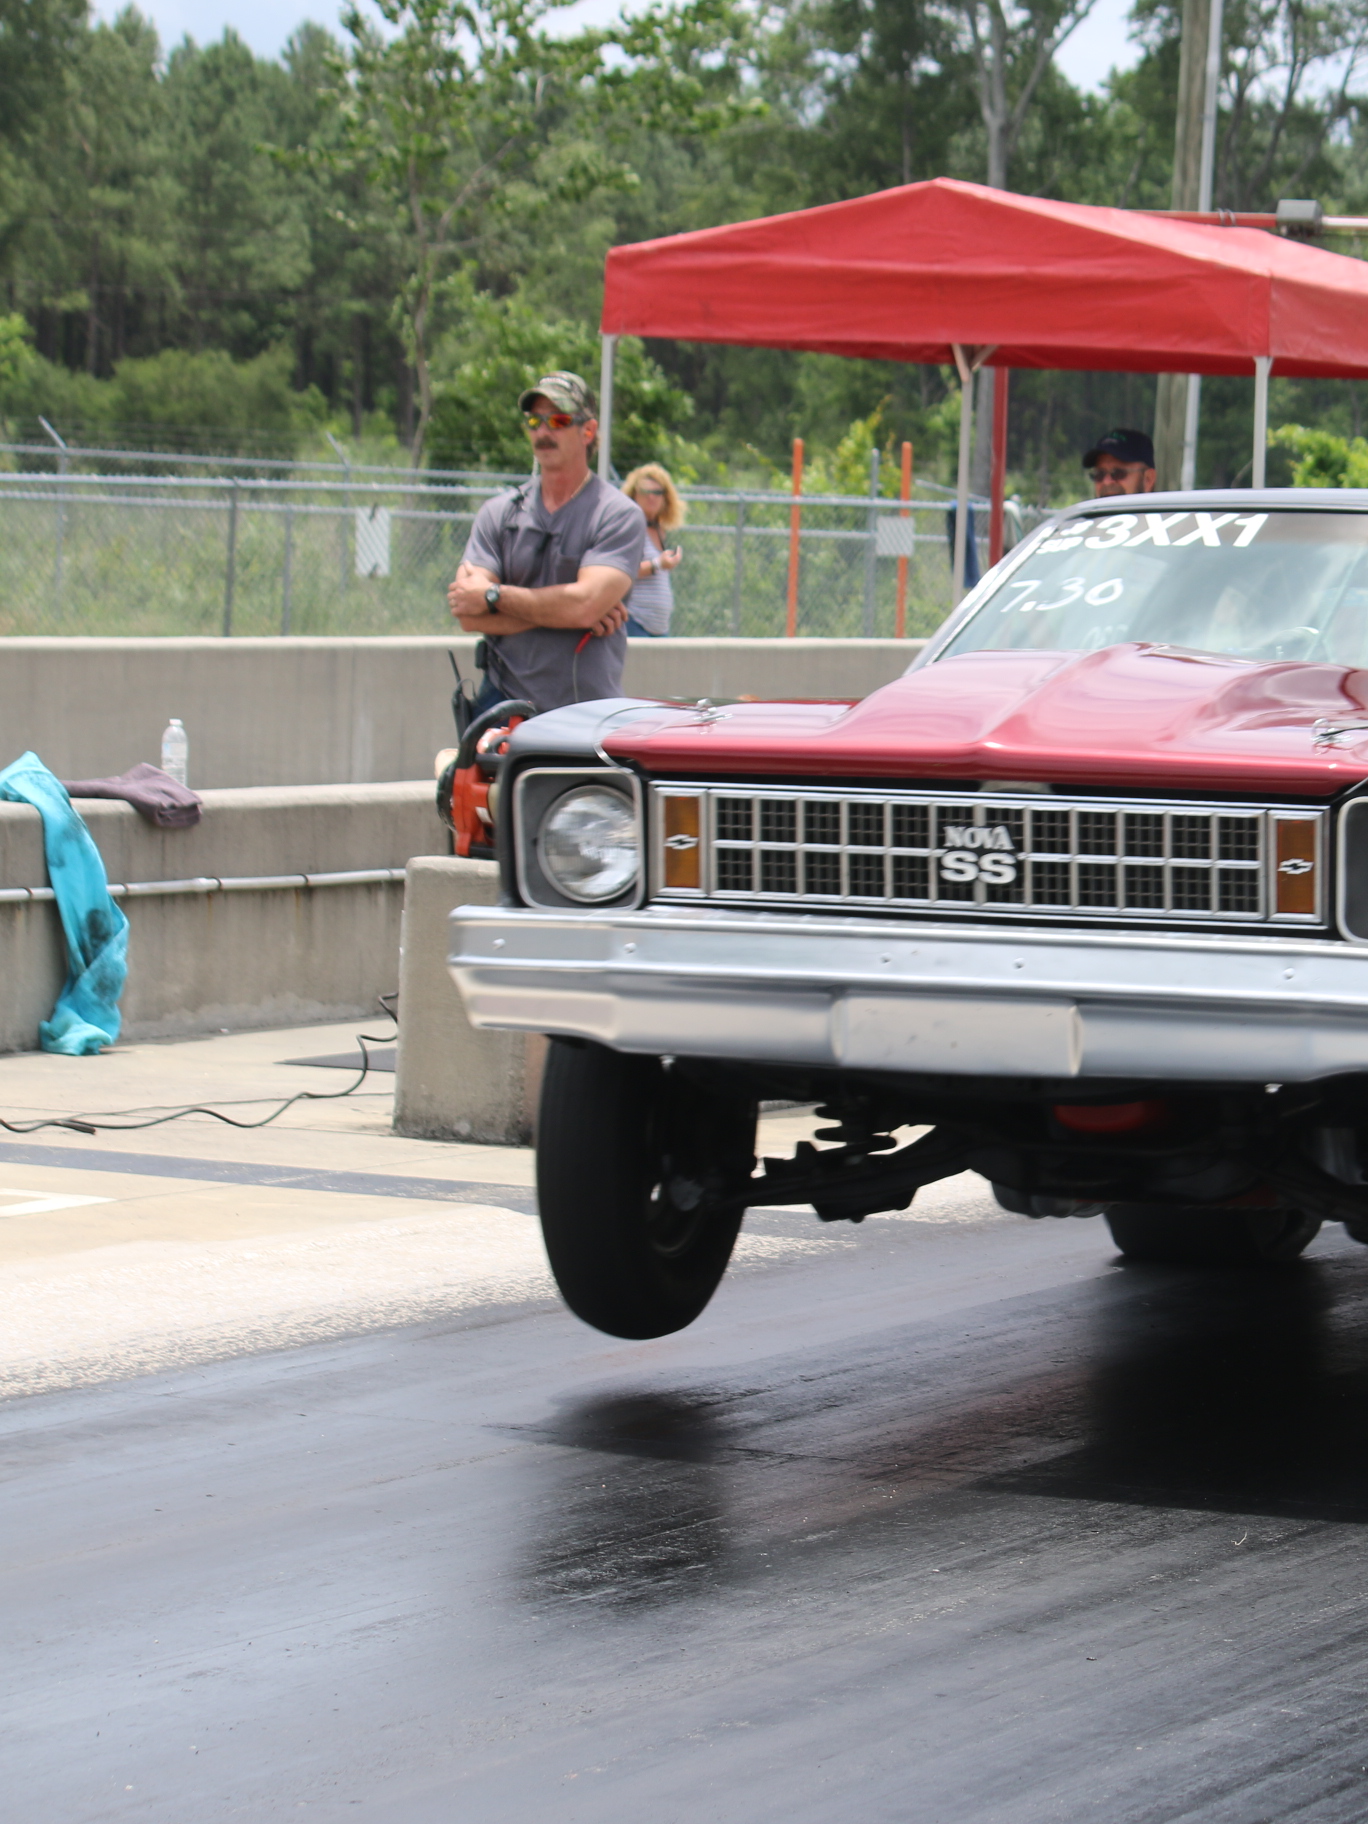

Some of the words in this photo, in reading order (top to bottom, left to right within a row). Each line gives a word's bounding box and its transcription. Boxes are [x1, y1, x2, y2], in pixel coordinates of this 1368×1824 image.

[1000, 577, 1123, 612] 7.30
[942, 825, 1015, 850] NOVA
[940, 850, 1017, 884] SS
